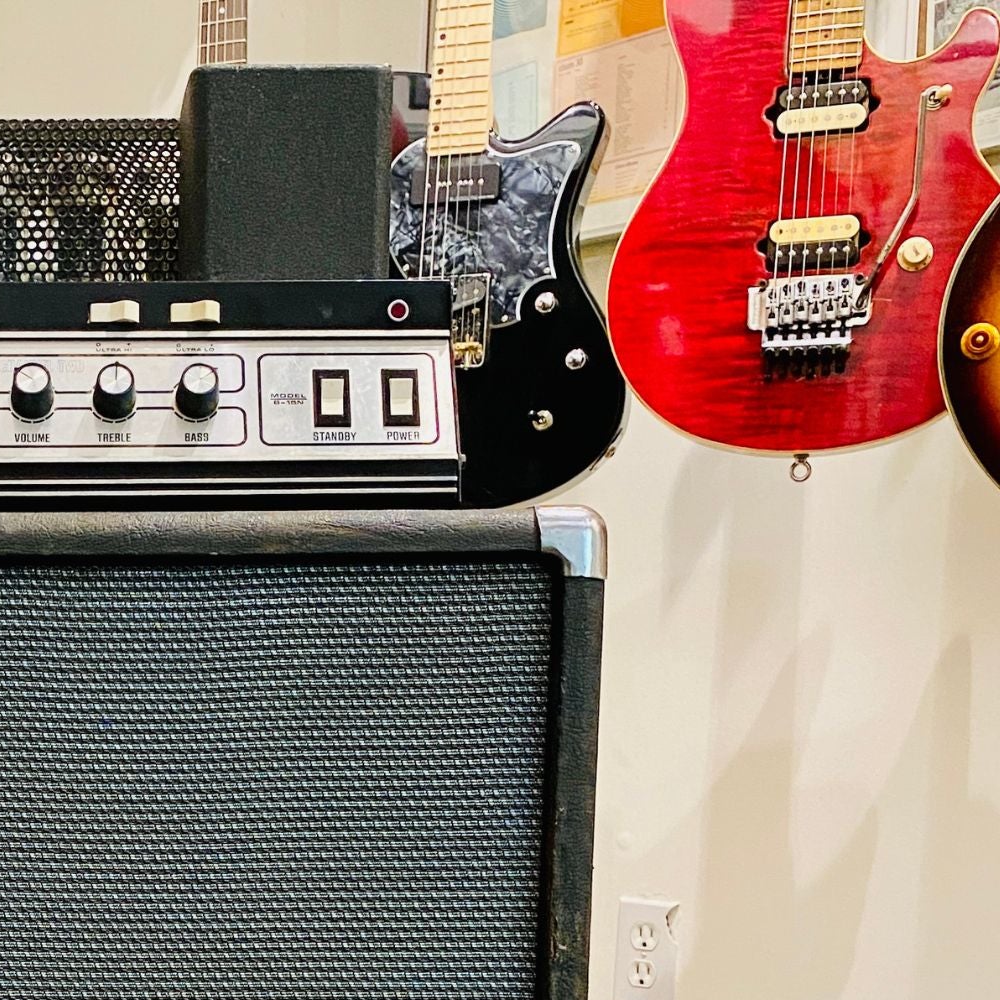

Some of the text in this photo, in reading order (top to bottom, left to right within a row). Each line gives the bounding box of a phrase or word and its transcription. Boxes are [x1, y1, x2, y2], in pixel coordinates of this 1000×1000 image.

[14, 433, 50, 443] VOLUME
[98, 433, 131, 443] TREBLE
[184, 433, 209, 443] BASS
[313, 432, 356, 441] STANDBY
[387, 432, 420, 441] POWER
